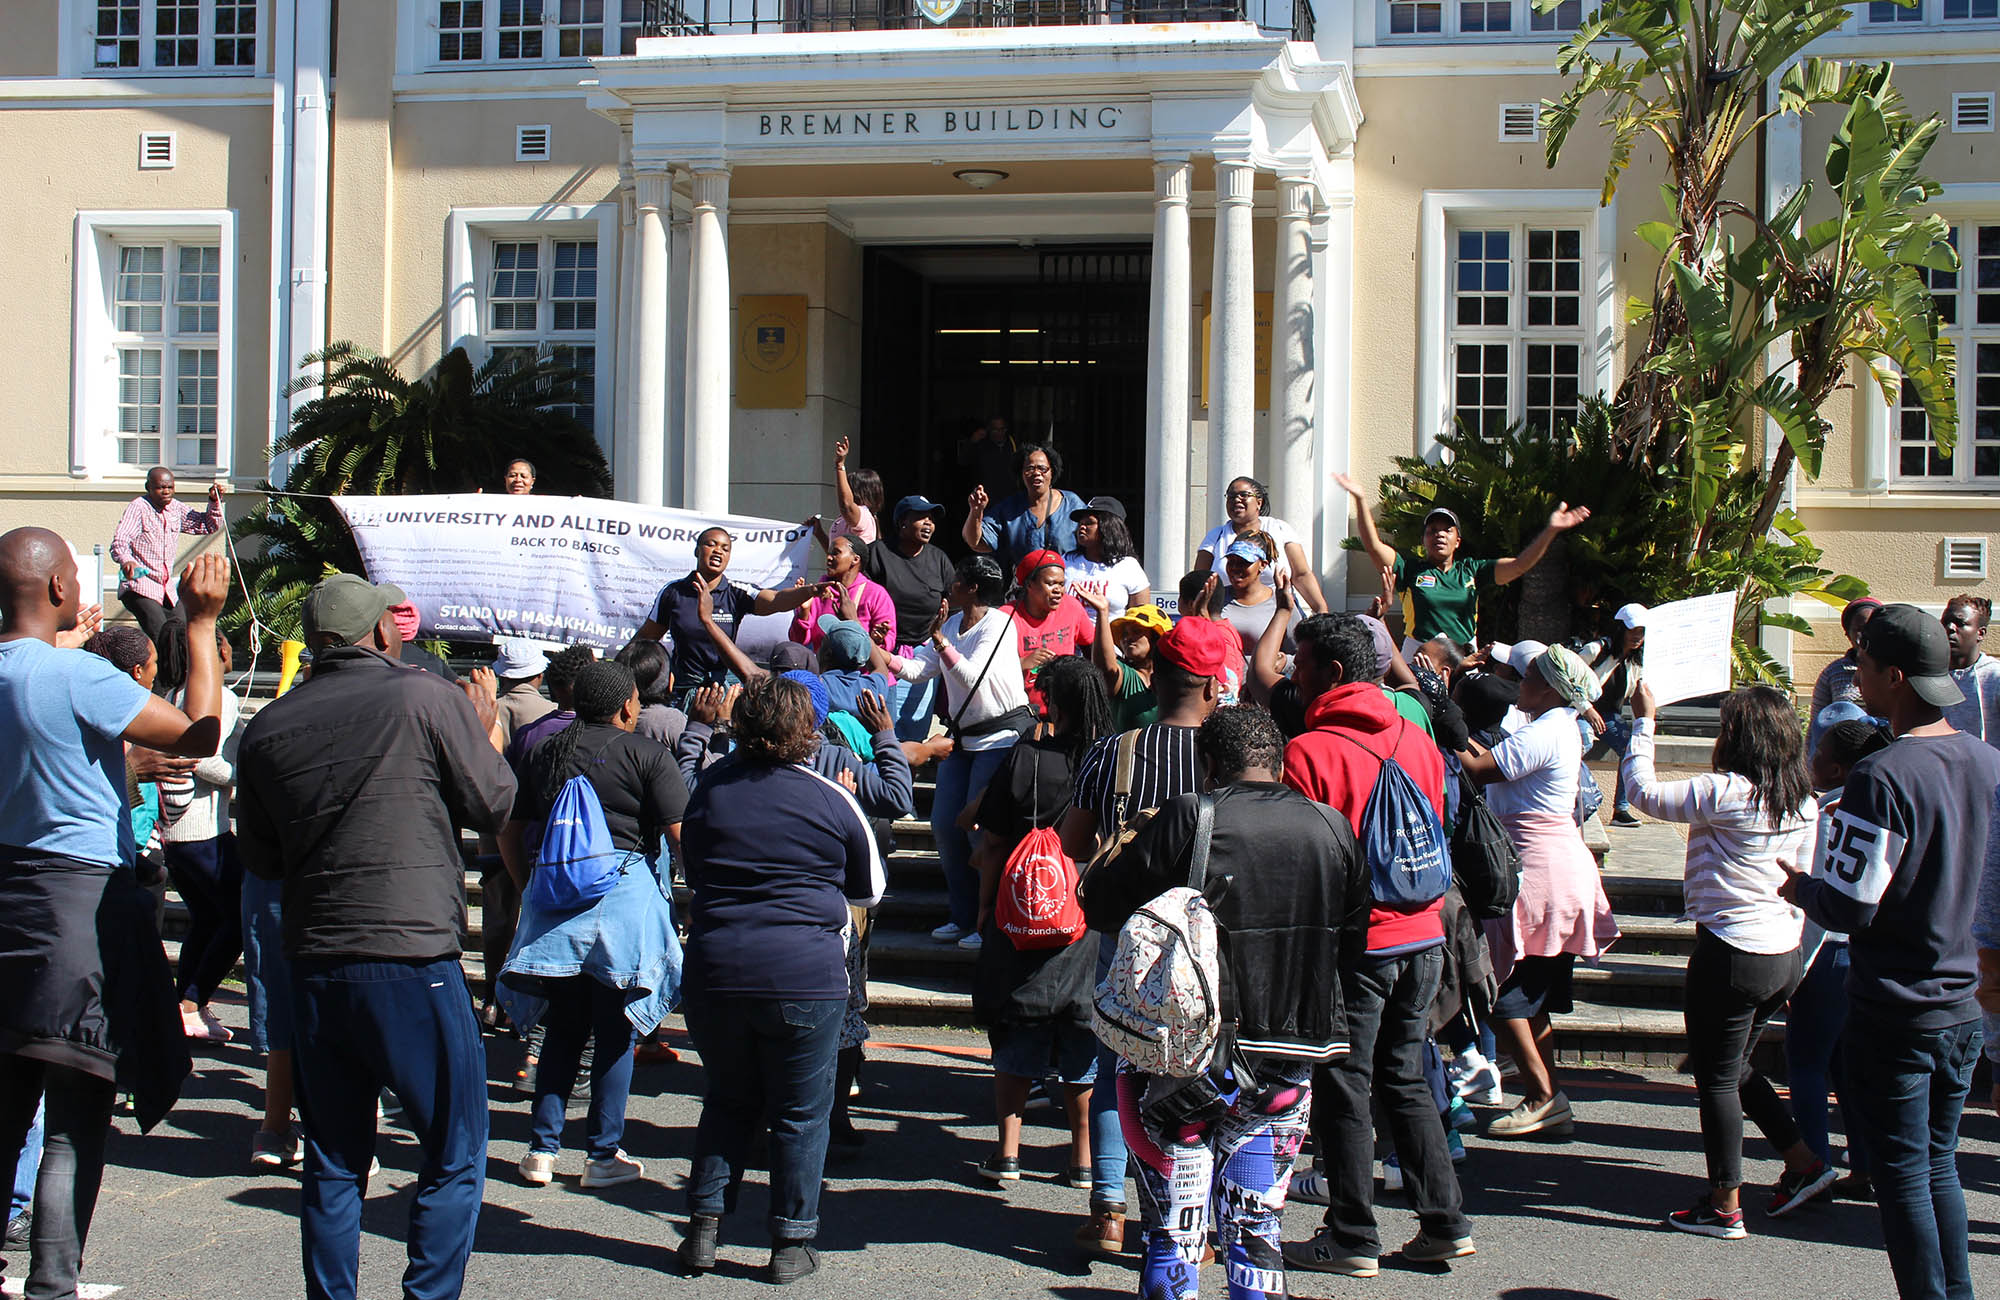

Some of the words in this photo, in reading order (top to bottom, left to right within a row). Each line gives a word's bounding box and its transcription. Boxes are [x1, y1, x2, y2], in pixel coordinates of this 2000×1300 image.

[759, 112, 920, 136] BREMNER
[944, 107, 1117, 132] BUILDING
[385, 511, 507, 527] UNIVERSITY
[512, 514, 555, 529] AND
[560, 514, 632, 537] ALLIED
[638, 523, 738, 542] WORKS
[511, 536, 547, 547] BACK
[550, 537, 568, 548] TO
[571, 540, 621, 556] BASICS
[434, 622, 459, 631] Contact
[439, 604, 492, 620] STAND
[496, 608, 519, 621] UP
[521, 610, 616, 639] MASAKHANE
[1023, 625, 1070, 651] EFF
[1229, 1261, 1282, 1292] LOVE
